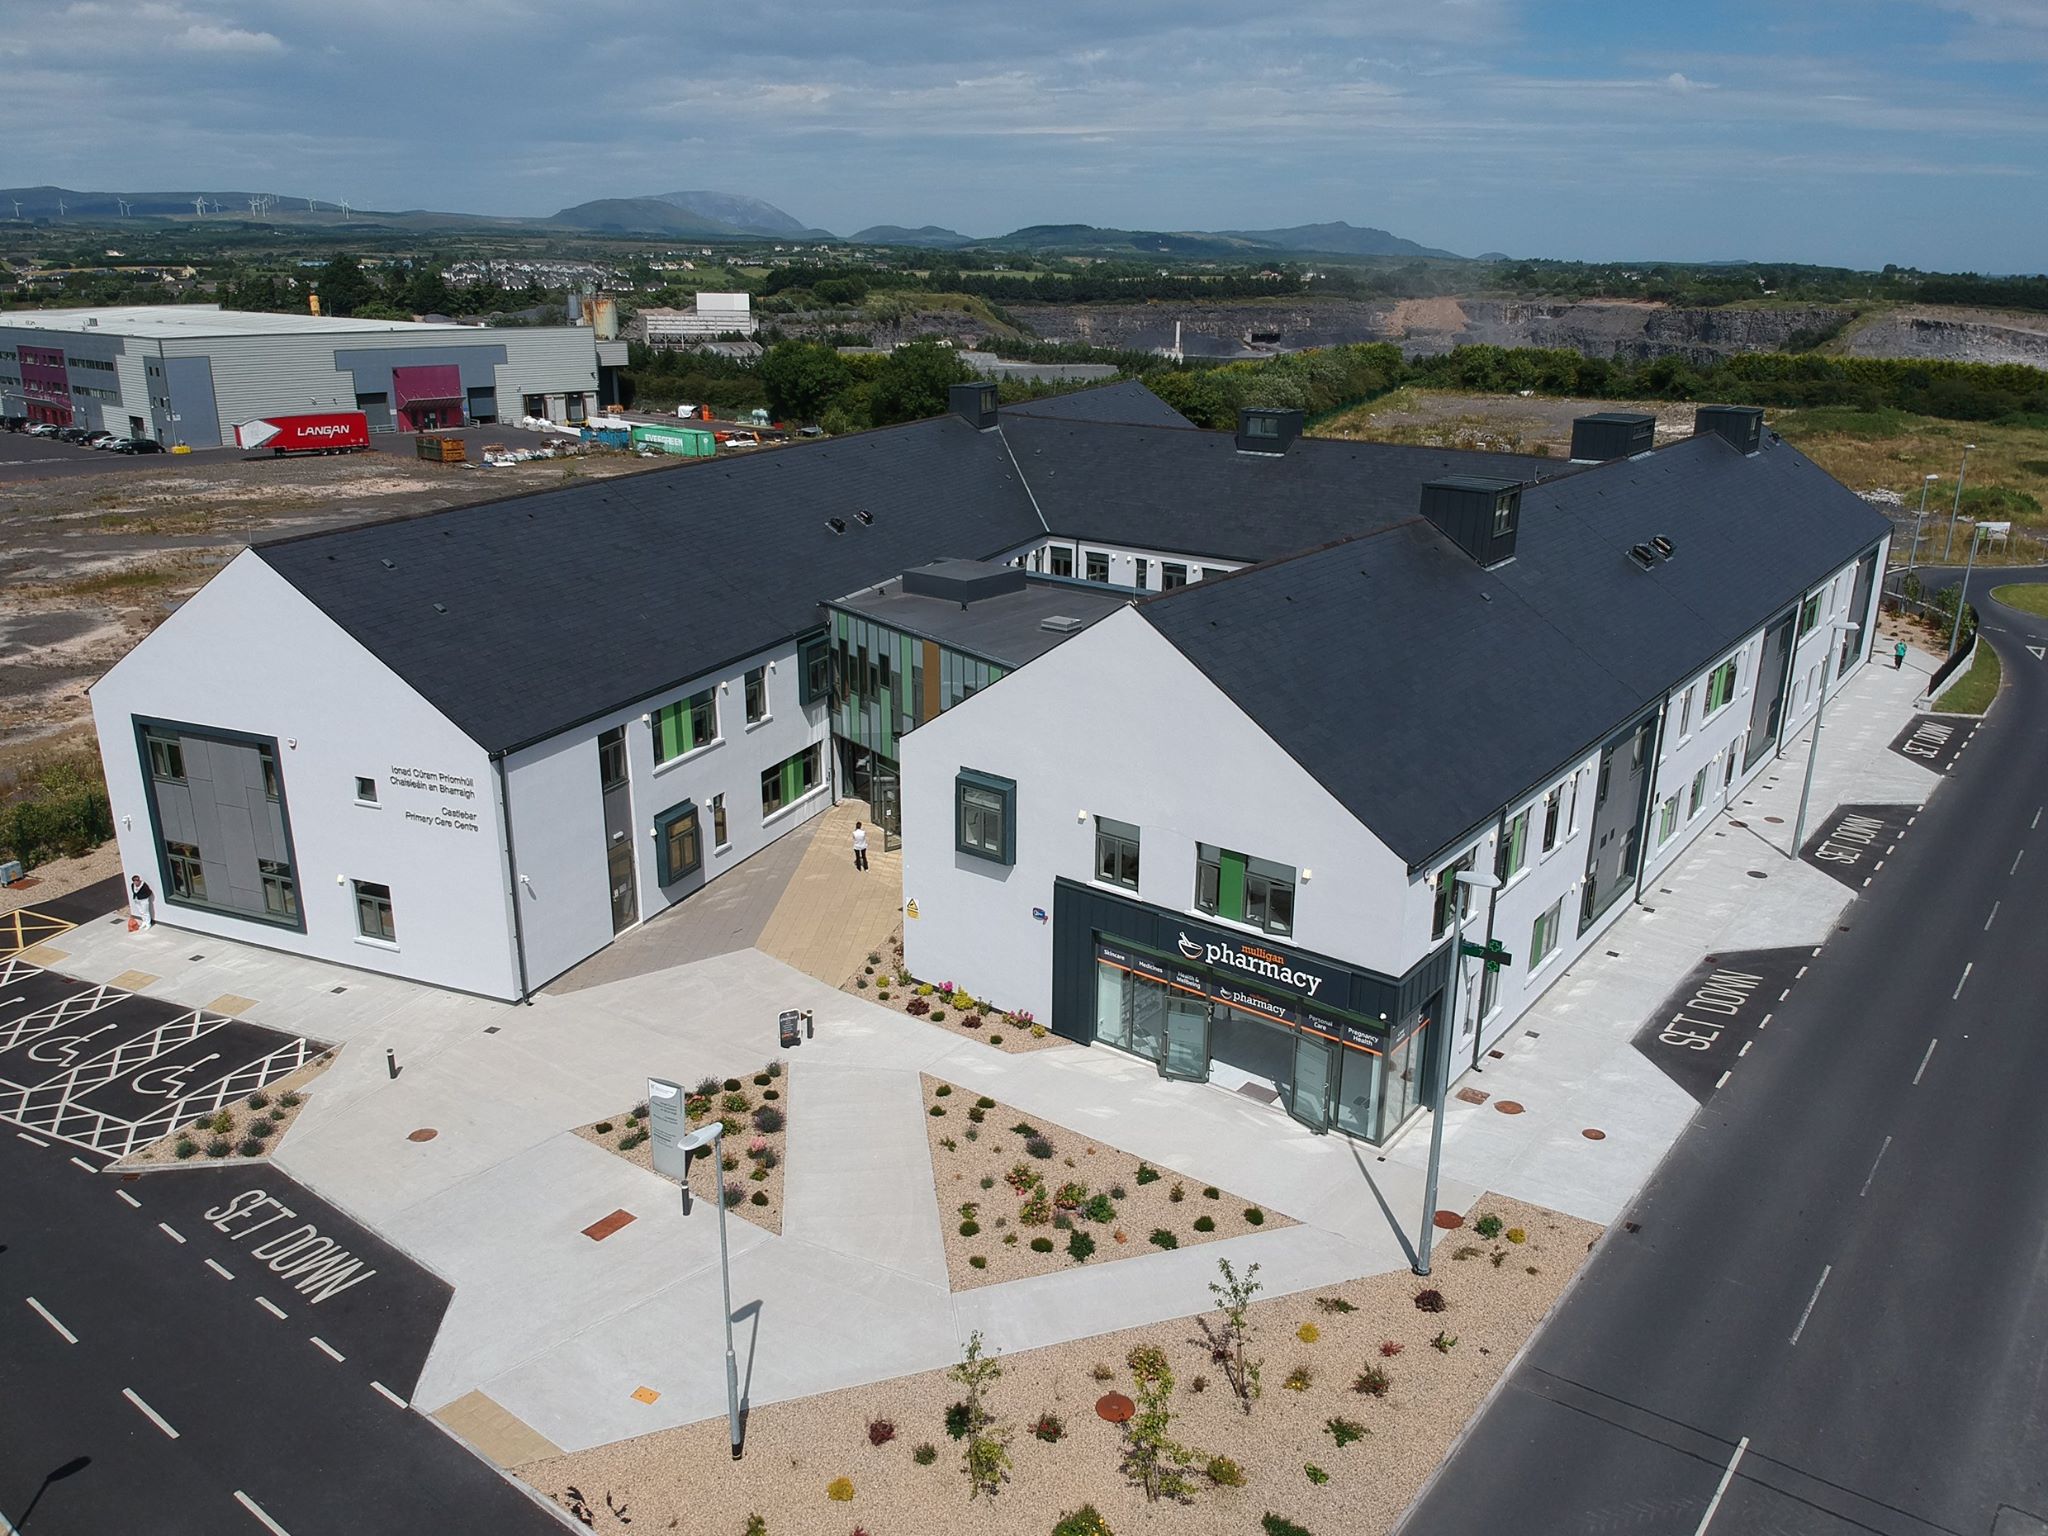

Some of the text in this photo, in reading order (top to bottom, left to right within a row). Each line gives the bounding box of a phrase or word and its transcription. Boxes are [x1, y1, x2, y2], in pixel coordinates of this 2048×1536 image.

[297, 425, 350, 438] LANGAN
[1902, 720, 1954, 758] SET DOWN
[391, 765, 412, 777] Ionad
[428, 784, 438, 792] an
[441, 807, 477, 820] Castlebar
[405, 811, 478, 832] Primary Care Centre
[1815, 813, 1884, 864] SET DOWN
[1103, 949, 1125, 961] Skincare
[1241, 945, 1285, 965] mulligan
[1138, 961, 1163, 973] Medicines
[1205, 942, 1322, 996] pharmacy
[1232, 991, 1286, 1017] pharmacy
[1658, 968, 1763, 1051] SET DOWN
[1308, 1014, 1333, 1027] Personal
[1313, 1022, 1327, 1031] Care
[1347, 1027, 1379, 1043] Pregnancy
[1353, 1035, 1373, 1046] Health
[204, 1189, 376, 1304] SET DOWN
